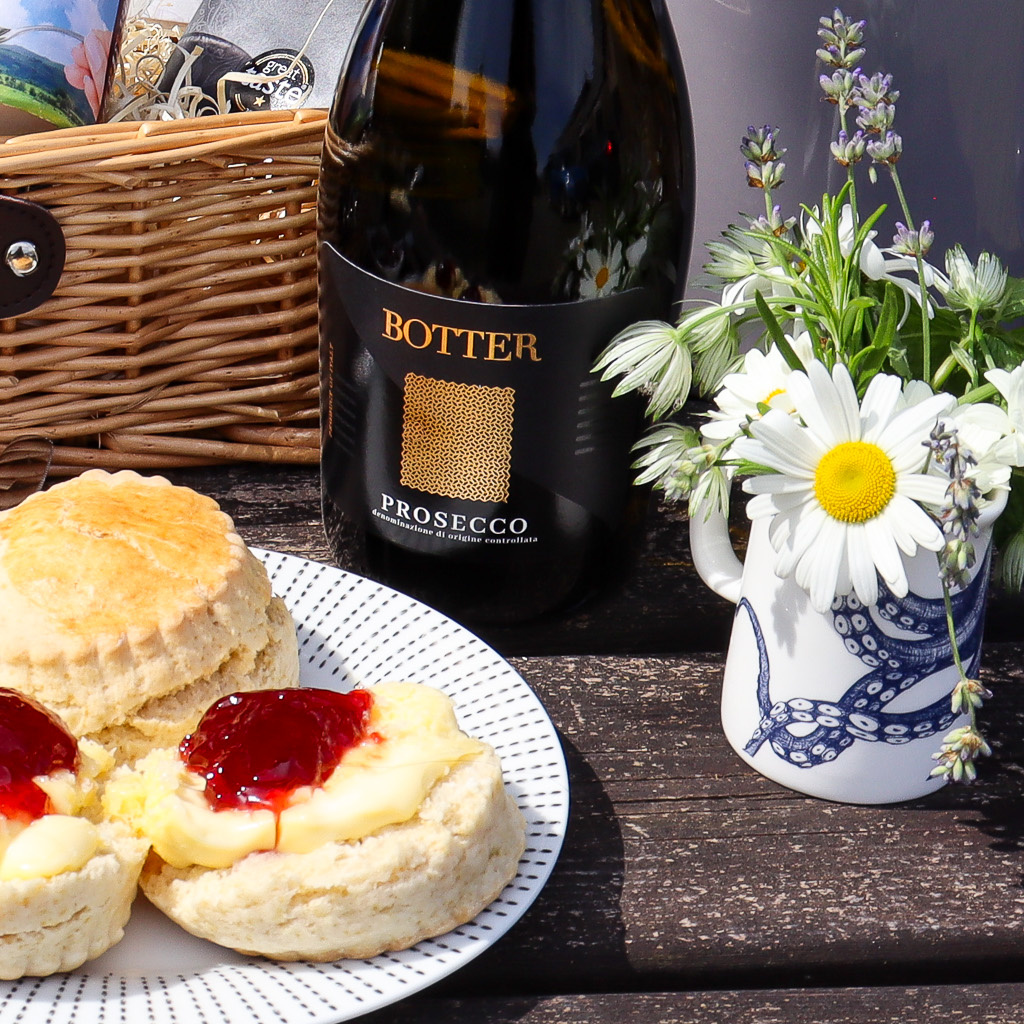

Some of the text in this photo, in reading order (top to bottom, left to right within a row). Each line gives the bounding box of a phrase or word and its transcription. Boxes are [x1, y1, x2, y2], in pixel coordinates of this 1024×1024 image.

[381, 307, 542, 362] BOTTER
[371, 508, 539, 544] denominazione di origine controllata
[380, 492, 529, 535] PROSECCO
